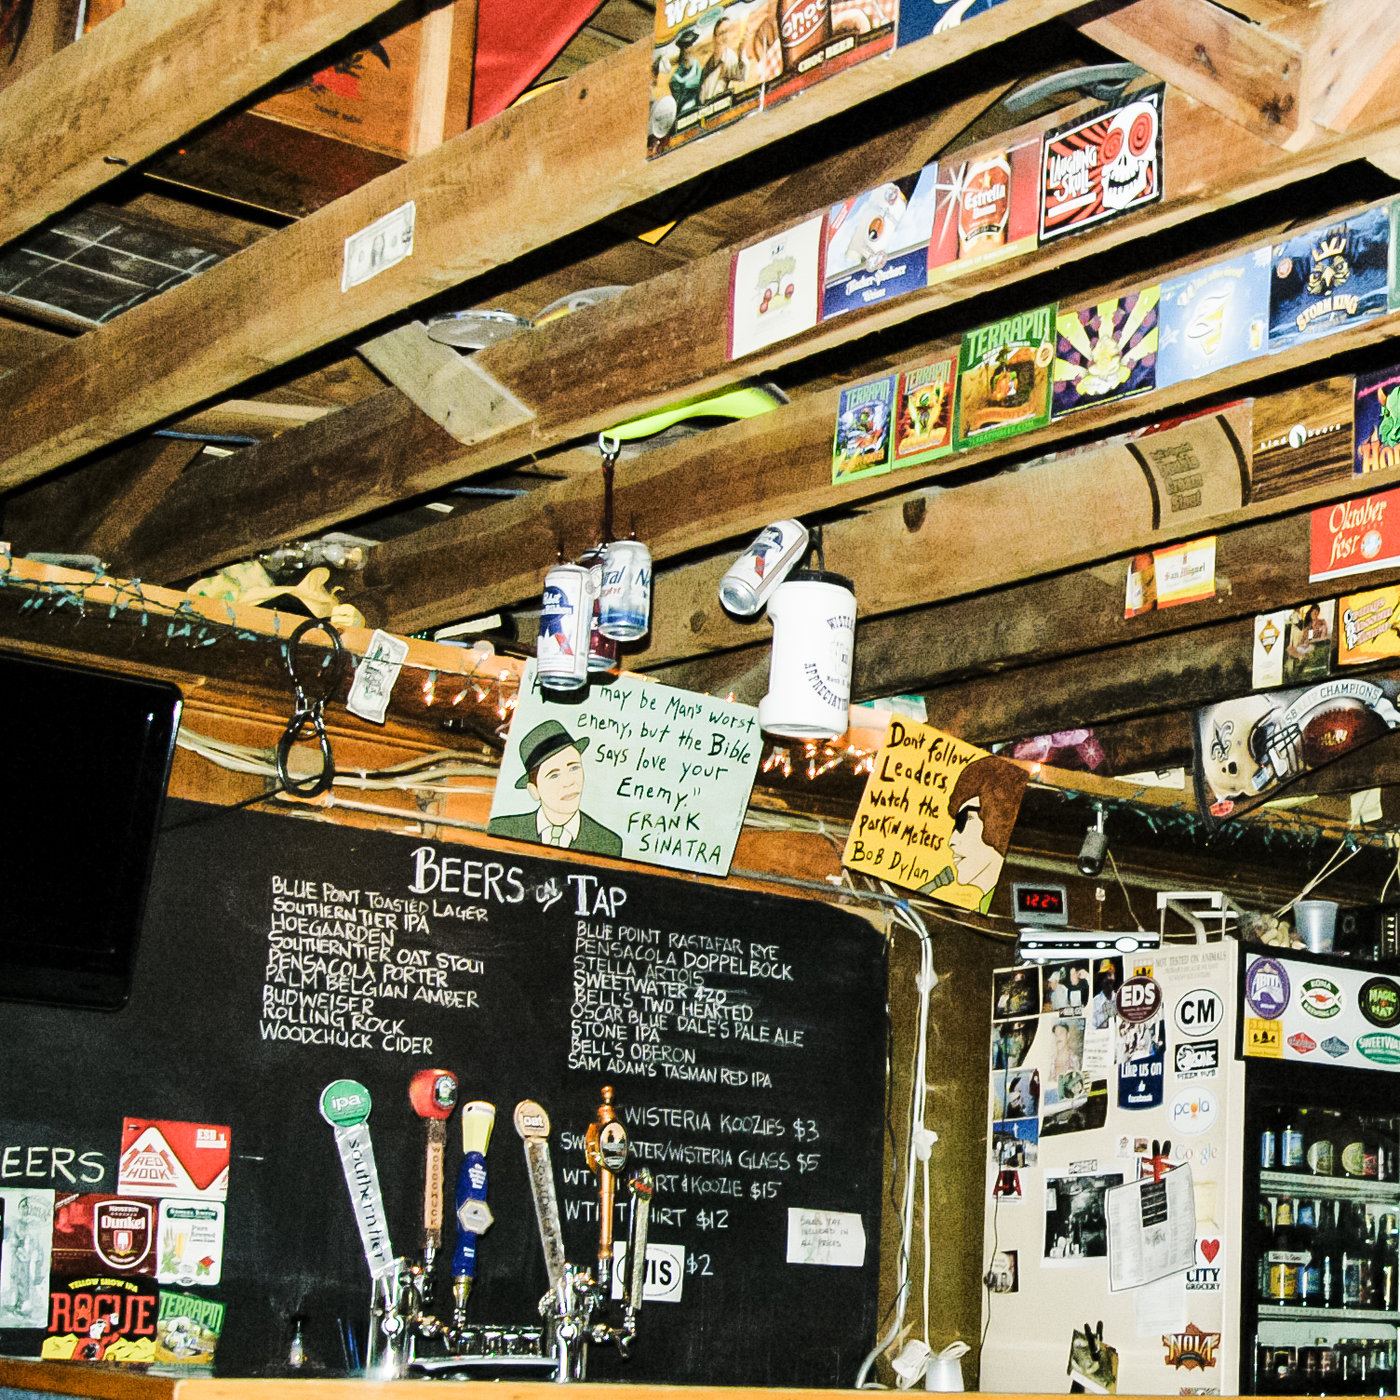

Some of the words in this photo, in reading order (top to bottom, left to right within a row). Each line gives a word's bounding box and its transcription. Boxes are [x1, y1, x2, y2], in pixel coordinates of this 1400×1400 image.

[967, 308, 1051, 364] TERRAPIN
[904, 360, 952, 395] TERRAPIN
[846, 379, 890, 405] TERRAPIN
[1320, 682, 1380, 702] CHAMPIONS
[600, 686, 633, 710] may
[640, 690, 656, 710] be
[664, 696, 703, 721] Man's
[709, 711, 755, 732] worst
[577, 713, 633, 741] enemy,
[640, 722, 670, 742] but
[678, 729, 702, 751] the
[707, 733, 751, 765] Bible
[886, 721, 926, 749] Don't
[928, 737, 976, 768] follow
[636, 747, 667, 772] love
[681, 762, 728, 784] your
[880, 755, 948, 794] Leaders,
[919, 795, 940, 819] the
[627, 811, 701, 834] FRANK
[888, 851, 929, 882] Dylan
[408, 846, 526, 905] BEERS
[567, 874, 628, 919] TAP
[272, 875, 317, 899] BLUE
[365, 891, 430, 915] TOASTED
[432, 899, 488, 922] LAGER
[271, 912, 395, 947] HOEGAARDEN
[404, 913, 430, 935] IPA
[575, 937, 677, 966] PENSACOLA
[576, 920, 613, 941] BLUE
[618, 926, 662, 945] POINT
[749, 943, 780, 961] RYE
[268, 949, 376, 983] PENSACOLA
[383, 964, 448, 988] PORTER
[396, 949, 432, 966] OAT
[573, 955, 636, 977] STELLA
[645, 966, 705, 987] ARTOIS
[265, 964, 317, 989] PALM
[326, 974, 408, 999] BELGIAN
[413, 986, 480, 1009] AMBER
[573, 969, 688, 1000] SWEETWATER
[1121, 983, 1156, 1008] EDS
[1369, 989, 1397, 1002] MAGIC
[263, 984, 374, 1015] BUDWEISER
[574, 987, 634, 1008] BELL'S
[641, 995, 674, 1015] TWO
[682, 1001, 753, 1023] HEARTED
[1180, 999, 1215, 1025] CM
[1371, 1005, 1393, 1017] HAT
[263, 1001, 346, 1032] ROLLING
[351, 1014, 405, 1036] ROCK
[570, 1002, 623, 1023] OSCAR
[628, 1011, 668, 1031] BLUE
[677, 1015, 730, 1039] DALE'S
[734, 1025, 771, 1044] PALE
[774, 1028, 805, 1048] ALE
[571, 1020, 628, 1042] STONE
[635, 1026, 661, 1043] IPA
[259, 1020, 373, 1049] WOODCHUCK
[382, 1034, 434, 1055] CIDER
[571, 1036, 625, 1059] BELL'S
[630, 1043, 696, 1064] OBERON
[568, 1053, 601, 1072] SAM
[607, 1060, 657, 1078] ADAM'S
[661, 1063, 717, 1084] TASMAN
[720, 1068, 748, 1086] RED
[752, 1072, 772, 1088] IPA
[1121, 1062, 1138, 1078] Like
[1139, 1063, 1149, 1075] us
[1150, 1062, 1162, 1076] on
[331, 1094, 361, 1111] ipa
[523, 1116, 543, 1128] oat
[624, 1106, 711, 1132] WISTERIA
[719, 1114, 786, 1136] KOOZIES
[792, 1118, 820, 1143] $3
[126, 1167, 170, 1181] HOOK
[132, 1156, 164, 1167] RED
[738, 1150, 791, 1172] GLASS
[796, 1153, 821, 1175] $5
[691, 1175, 743, 1197] KOOZIE
[750, 1180, 782, 1201] $15
[101, 1216, 146, 1230] Dunkel
[696, 1210, 729, 1229] $12
[686, 1253, 714, 1277] $2
[1186, 1268, 1221, 1283] CITY
[68, 1278, 99, 1290] YELLOW
[125, 1282, 138, 1293] IPA
[1185, 1283, 1221, 1291] GROCERY
[159, 1295, 224, 1332] TERRAPIN
